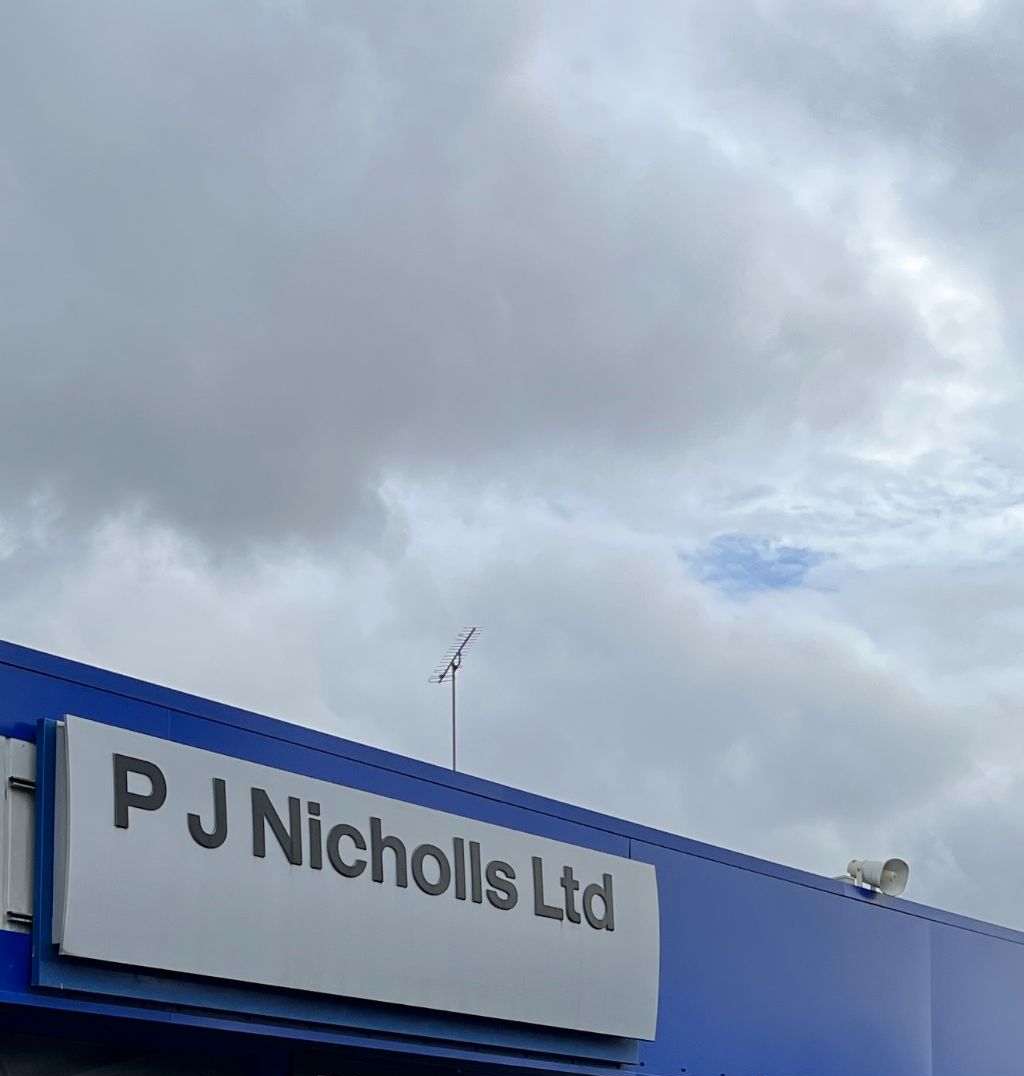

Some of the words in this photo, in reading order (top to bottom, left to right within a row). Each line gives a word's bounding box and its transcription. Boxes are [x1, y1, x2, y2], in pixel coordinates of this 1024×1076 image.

[111, 753, 167, 829] P
[186, 778, 228, 849] J
[250, 787, 518, 911] Nicholls
[532, 856, 615, 931] Ltd
